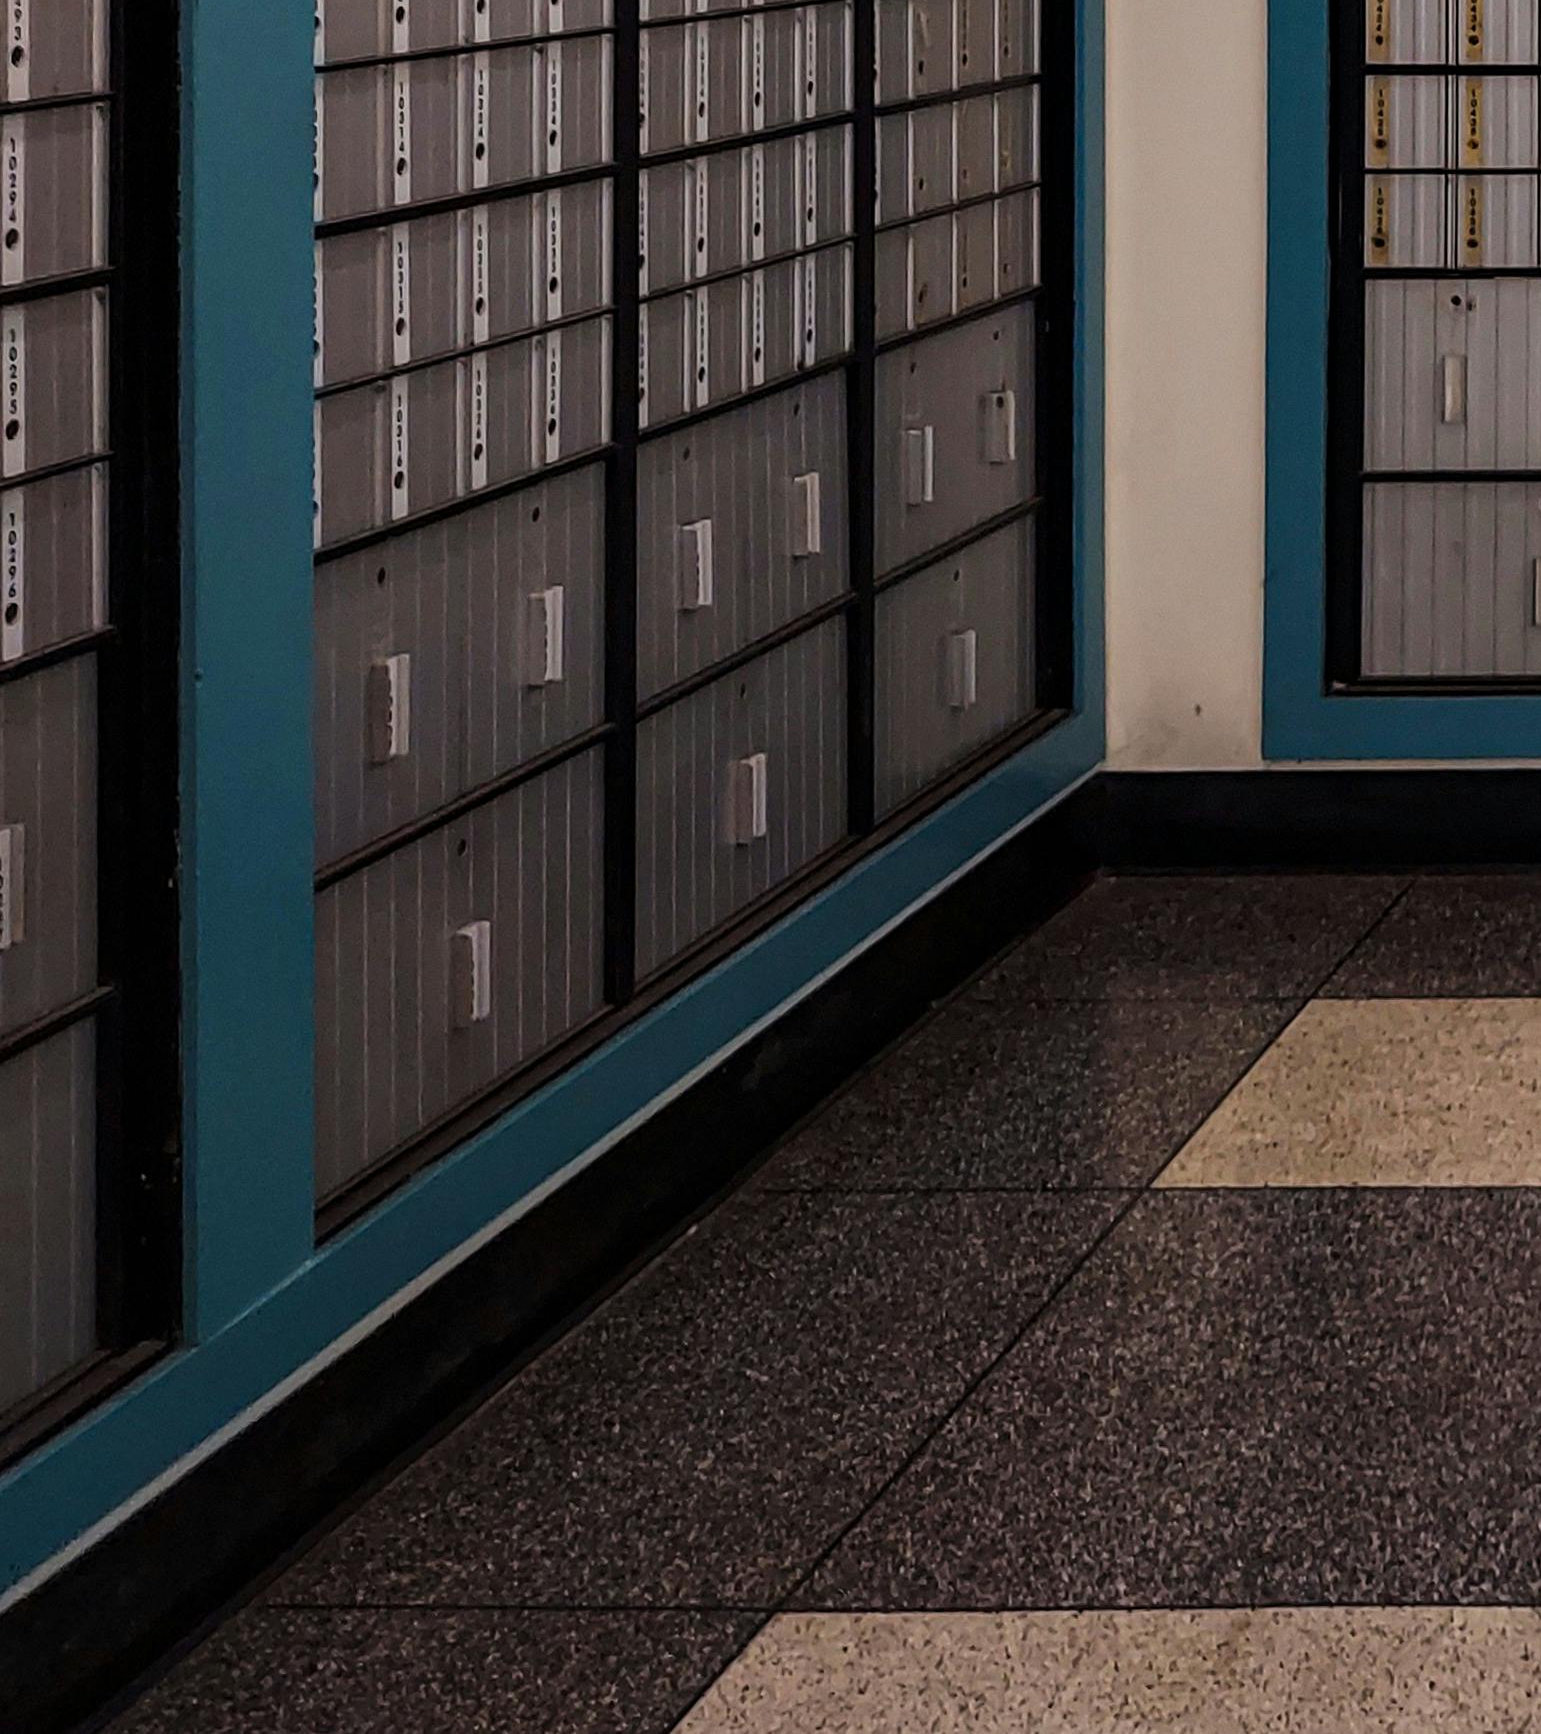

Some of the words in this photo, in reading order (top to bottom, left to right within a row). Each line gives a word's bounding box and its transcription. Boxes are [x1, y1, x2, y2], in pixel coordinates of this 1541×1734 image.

[8, 137, 18, 224] 10294
[8, 327, 18, 416] 10295
[7, 512, 17, 599] 10296
